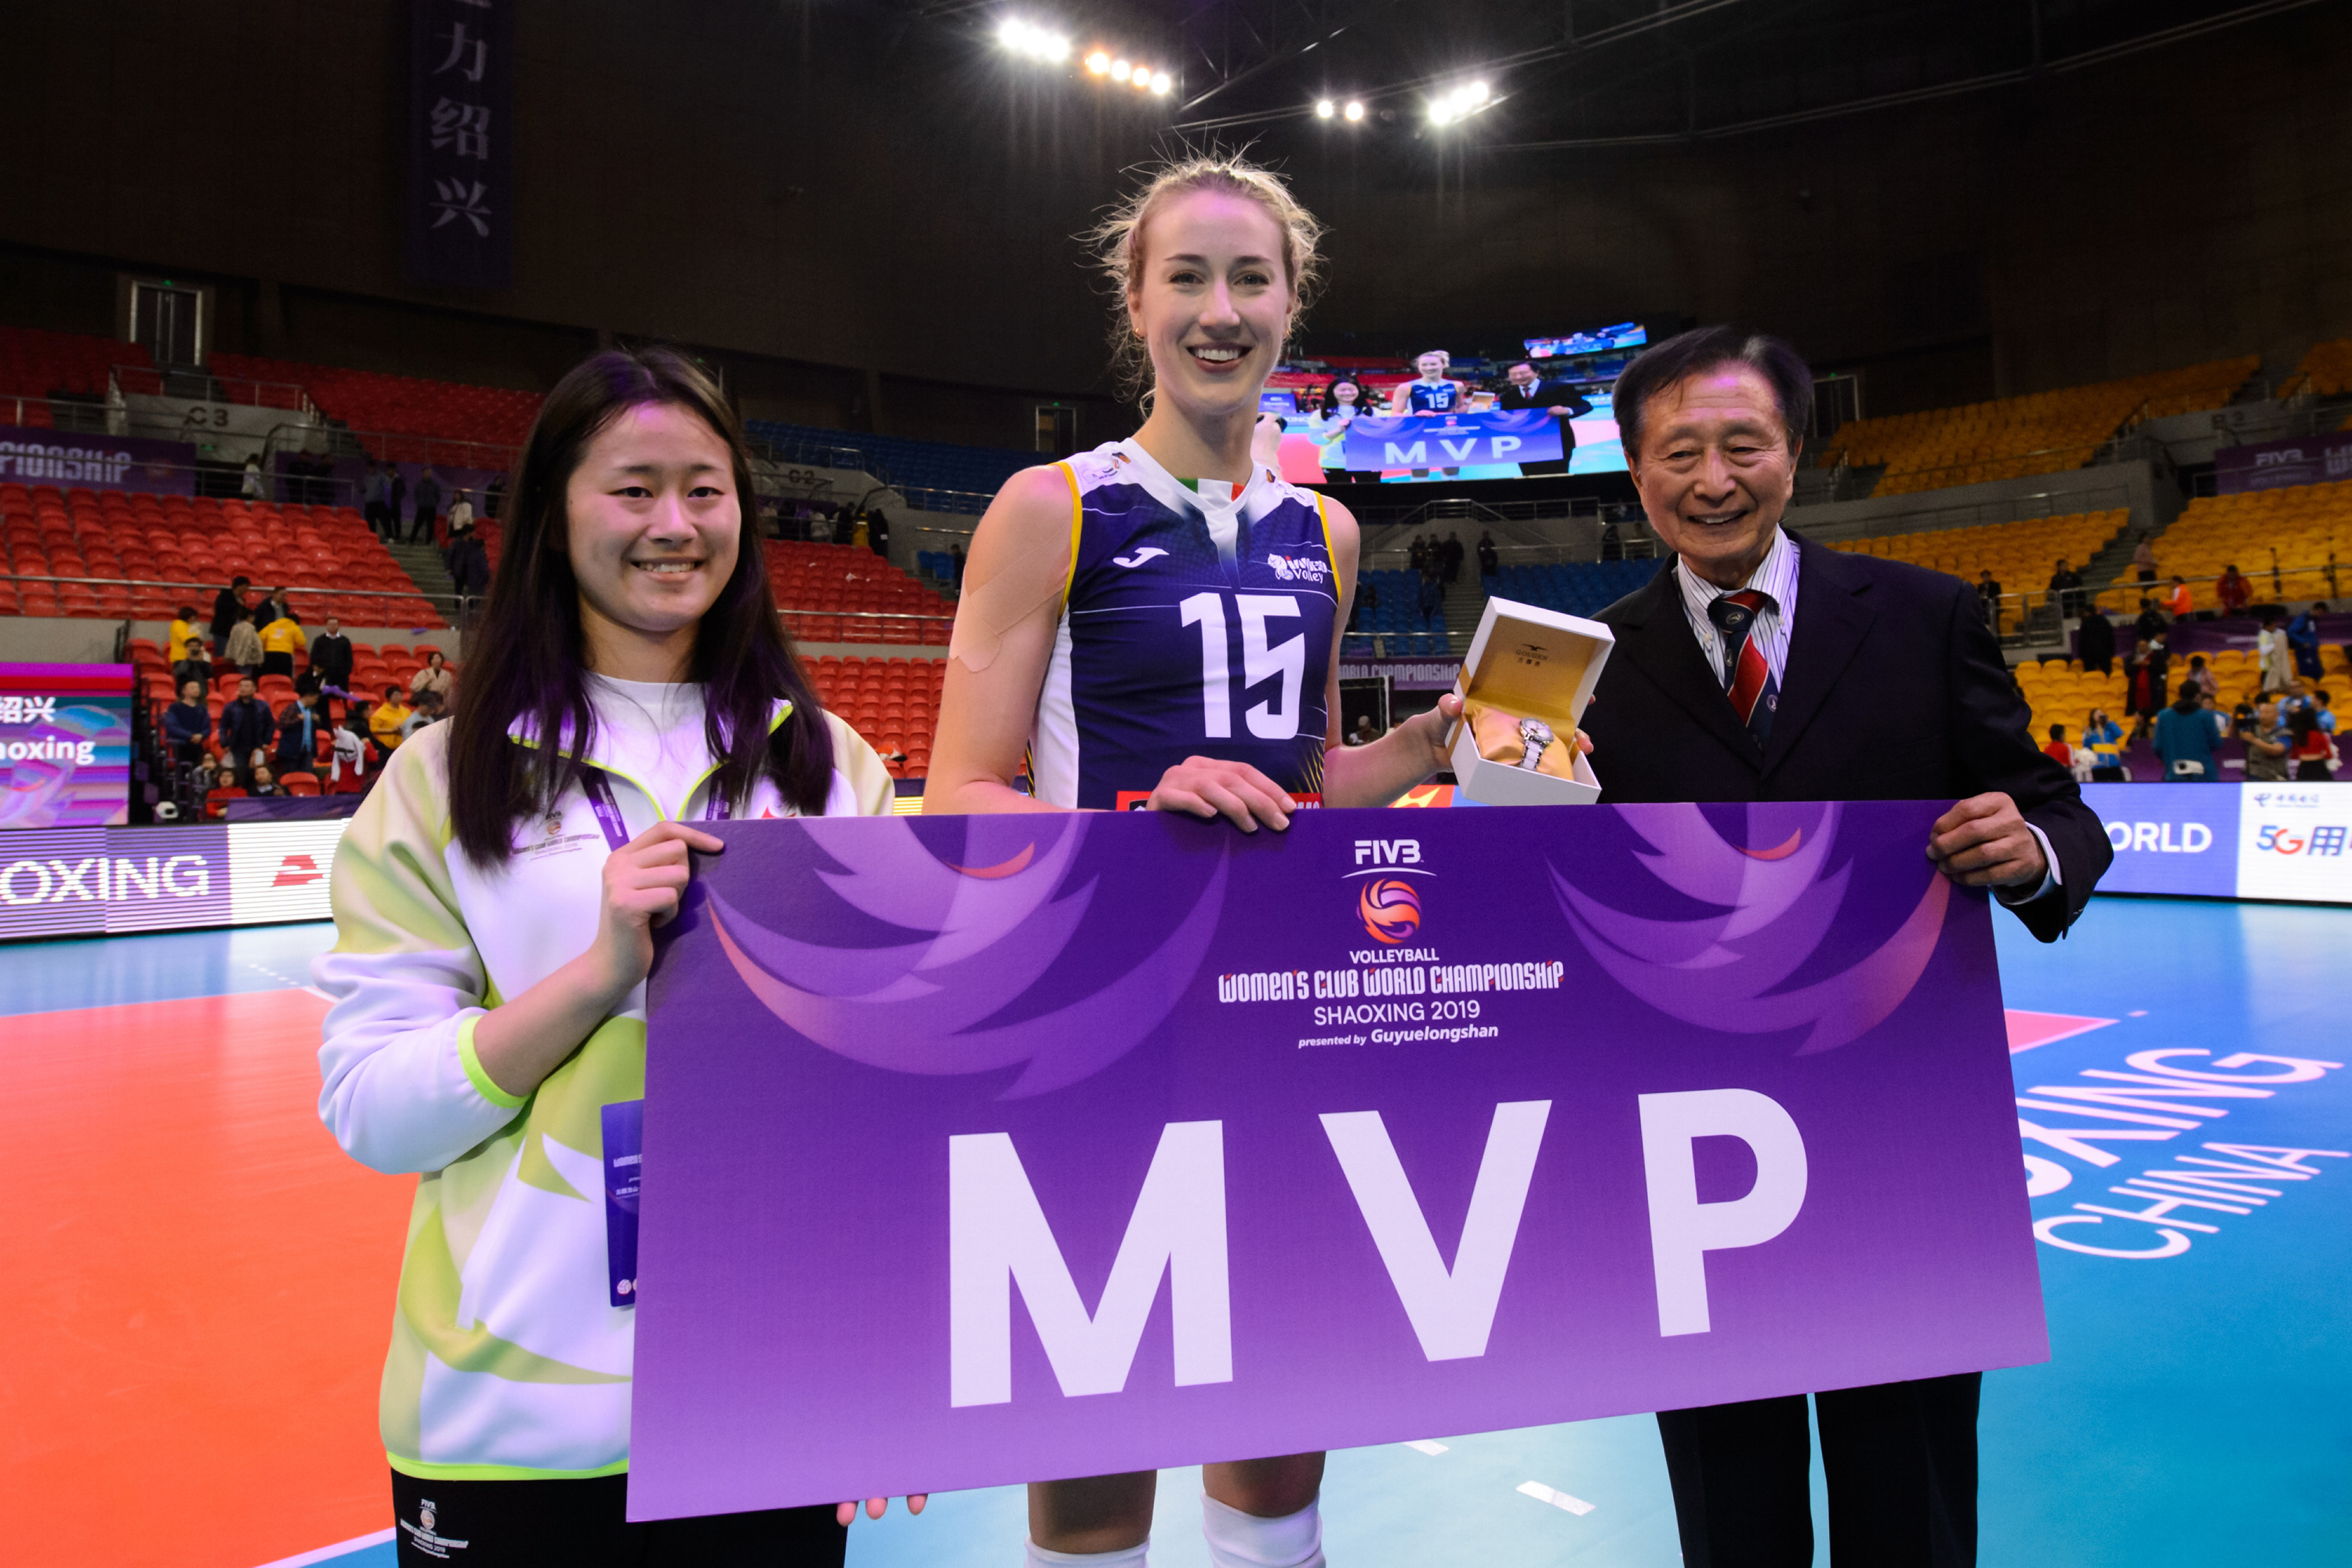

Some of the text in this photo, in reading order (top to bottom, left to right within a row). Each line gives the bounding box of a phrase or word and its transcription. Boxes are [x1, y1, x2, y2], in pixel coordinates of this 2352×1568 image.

[429, 0, 493, 238] 力绍兴
[1425, 393, 1449, 408] 15
[1385, 436, 1521, 464] MVP
[1180, 592, 1305, 739] 15
[1355, 839, 1421, 865] FIVB
[2101, 821, 2212, 853] ORLD
[2256, 825, 2352, 856] 5G用
[1349, 947, 1439, 964] VOLLEYBALL
[1314, 968, 1359, 1000] CLUB
[1363, 966, 1426, 997] WORLD
[1429, 960, 1565, 995] CHAMPIONSHIP
[1313, 999, 1481, 1026] SHAOXING 2019
[1298, 1024, 1499, 1049] presented by Guyuelongshan
[2032, 1142, 2352, 1260] CHINA
[949, 1087, 1808, 1408] MVP
